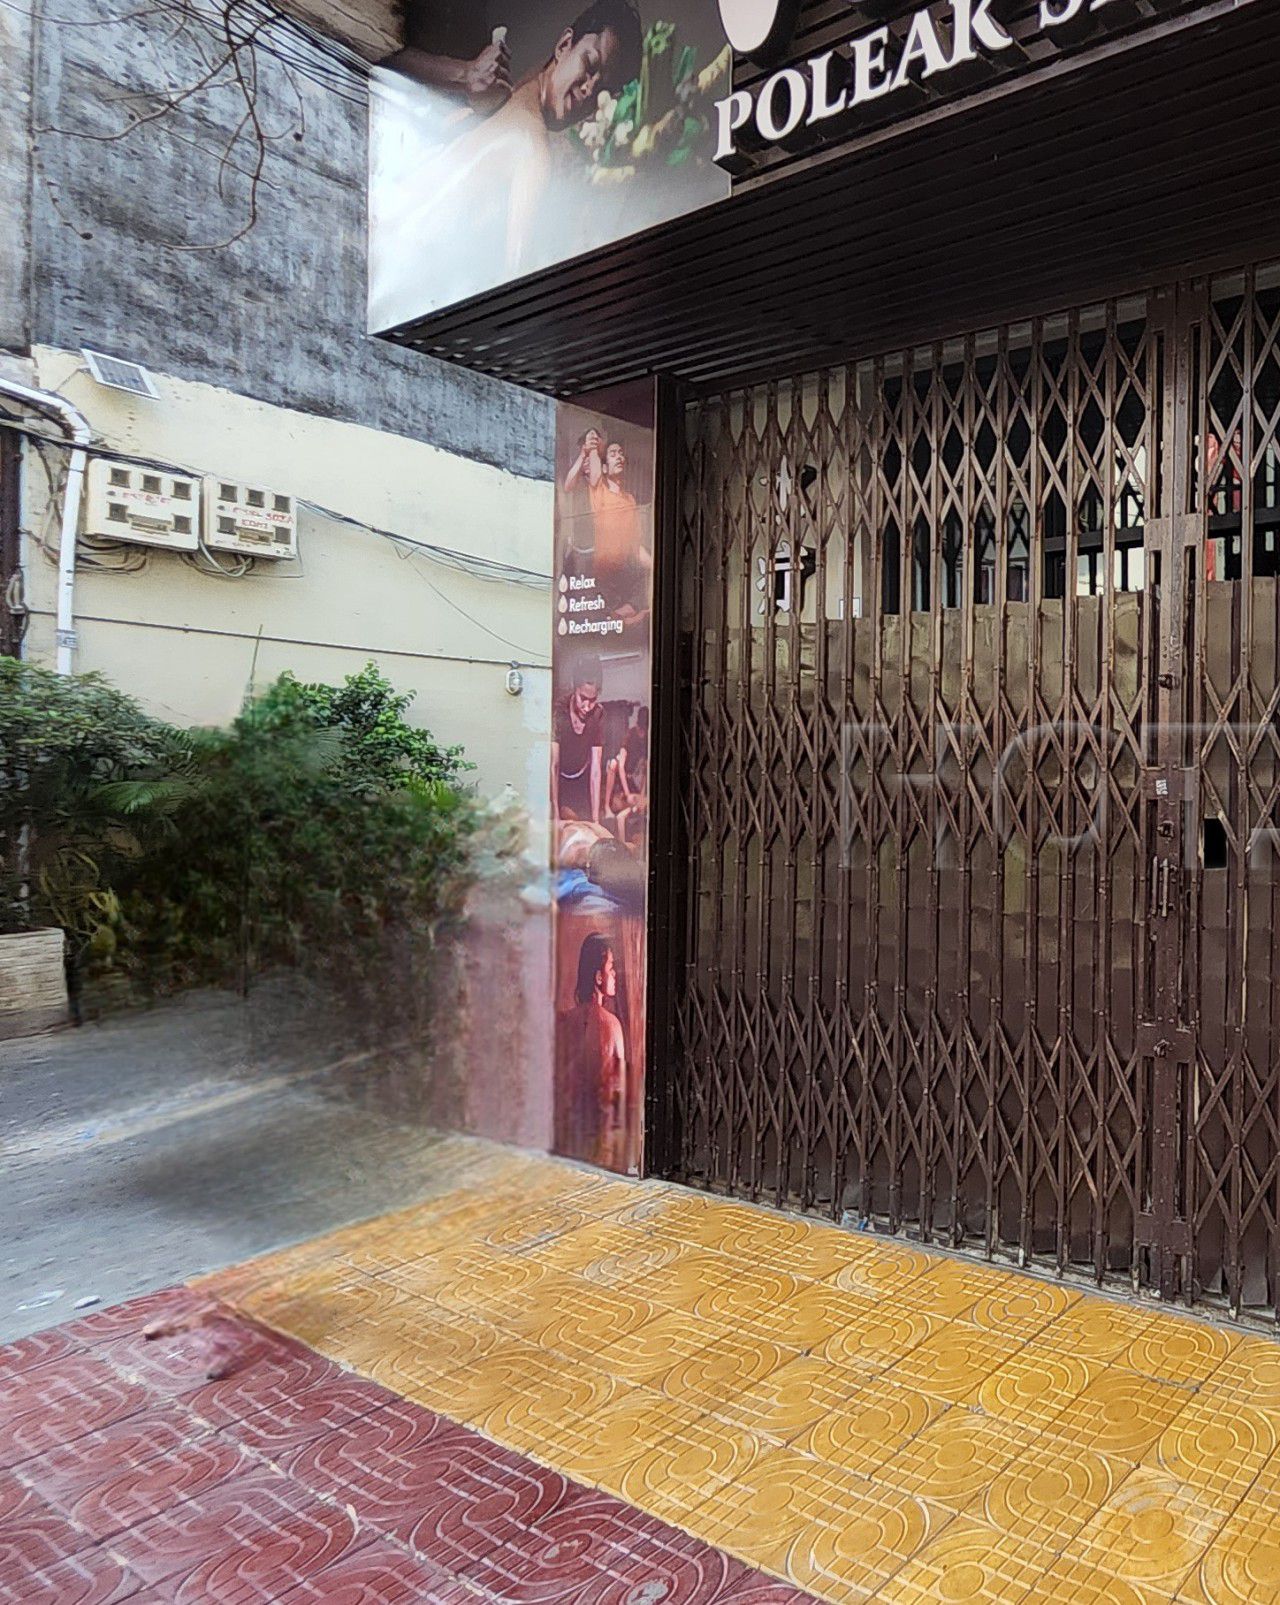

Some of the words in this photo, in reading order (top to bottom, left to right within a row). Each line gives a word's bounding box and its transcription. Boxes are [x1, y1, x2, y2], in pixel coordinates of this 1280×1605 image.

[712, 0, 1013, 163] POLEAK
[569, 574, 596, 590] Relax
[568, 594, 605, 612] Refresh
[568, 616, 624, 635] Recharging
